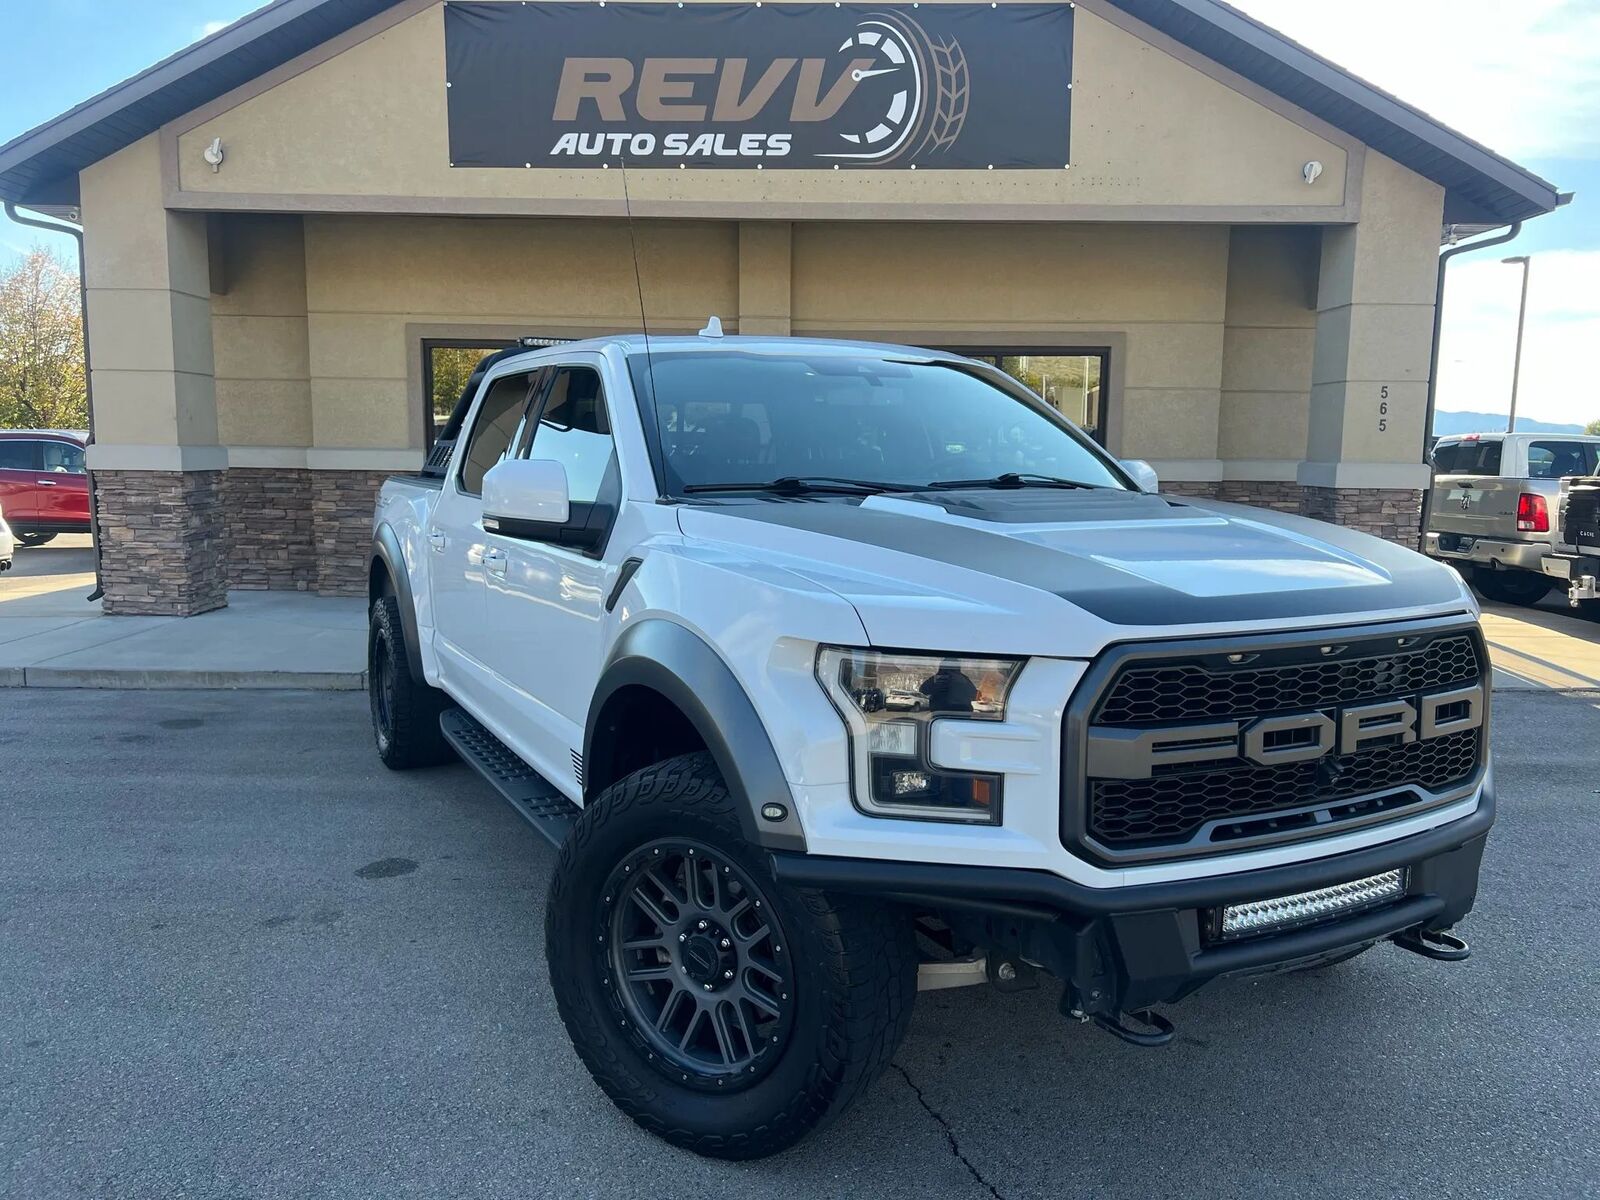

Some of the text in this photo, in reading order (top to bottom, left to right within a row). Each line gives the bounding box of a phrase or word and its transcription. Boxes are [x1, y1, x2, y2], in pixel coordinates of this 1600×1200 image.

[551, 57, 876, 122] REVV
[550, 133, 792, 156] AUTO SALES
[1379, 385, 1388, 432] 565
[1087, 685, 1484, 779] FORD
